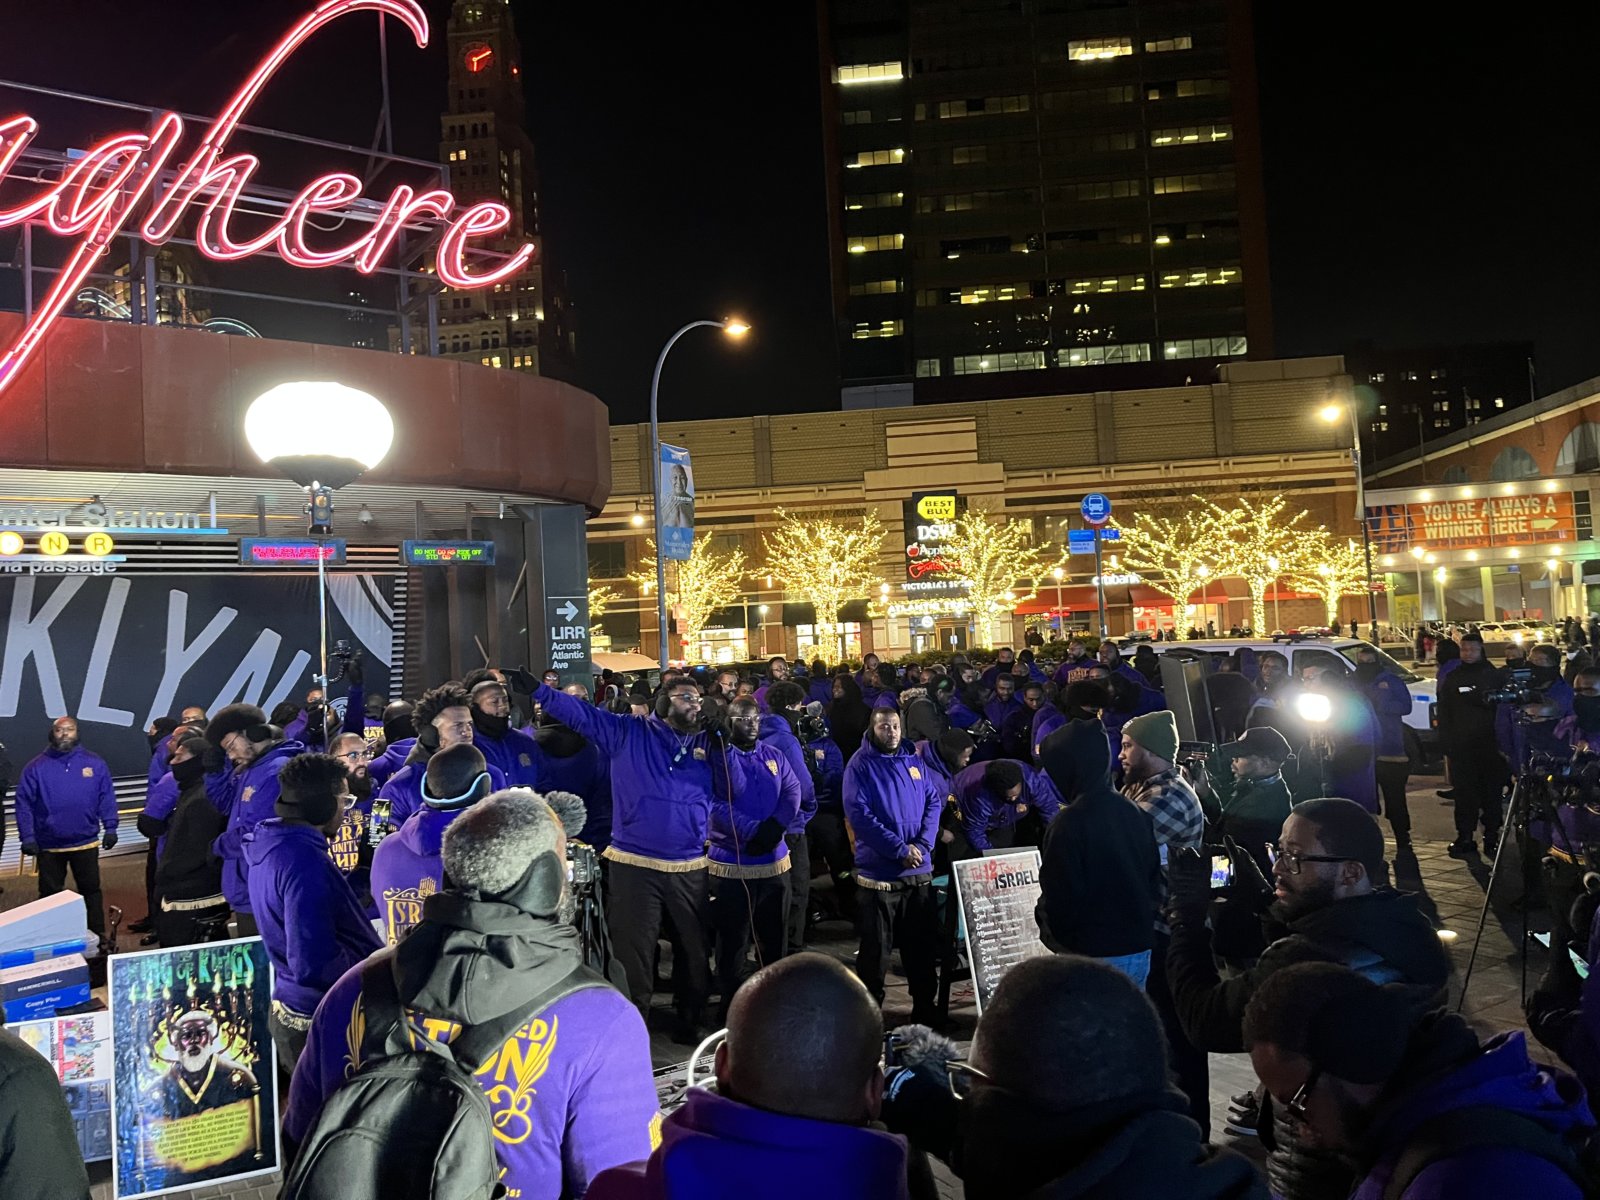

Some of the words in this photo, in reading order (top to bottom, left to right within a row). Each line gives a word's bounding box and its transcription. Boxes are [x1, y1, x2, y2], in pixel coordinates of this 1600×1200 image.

[82, 501, 200, 529] Station
[1422, 502, 1476, 521] YOU'RE
[1481, 498, 1541, 518] ALWAYS
[1545, 496, 1557, 513] A
[1424, 519, 1484, 540] WINNER
[1490, 516, 1528, 535] HERE
[48, 536, 62, 550] N
[93, 537, 106, 551] R
[30, 561, 117, 576] passage
[551, 626, 586, 640] LIRR
[551, 642, 582, 651] Across
[552, 651, 584, 660] Atlantic
[552, 661, 569, 670] Ave
[995, 870, 1040, 890] ISRAEL
